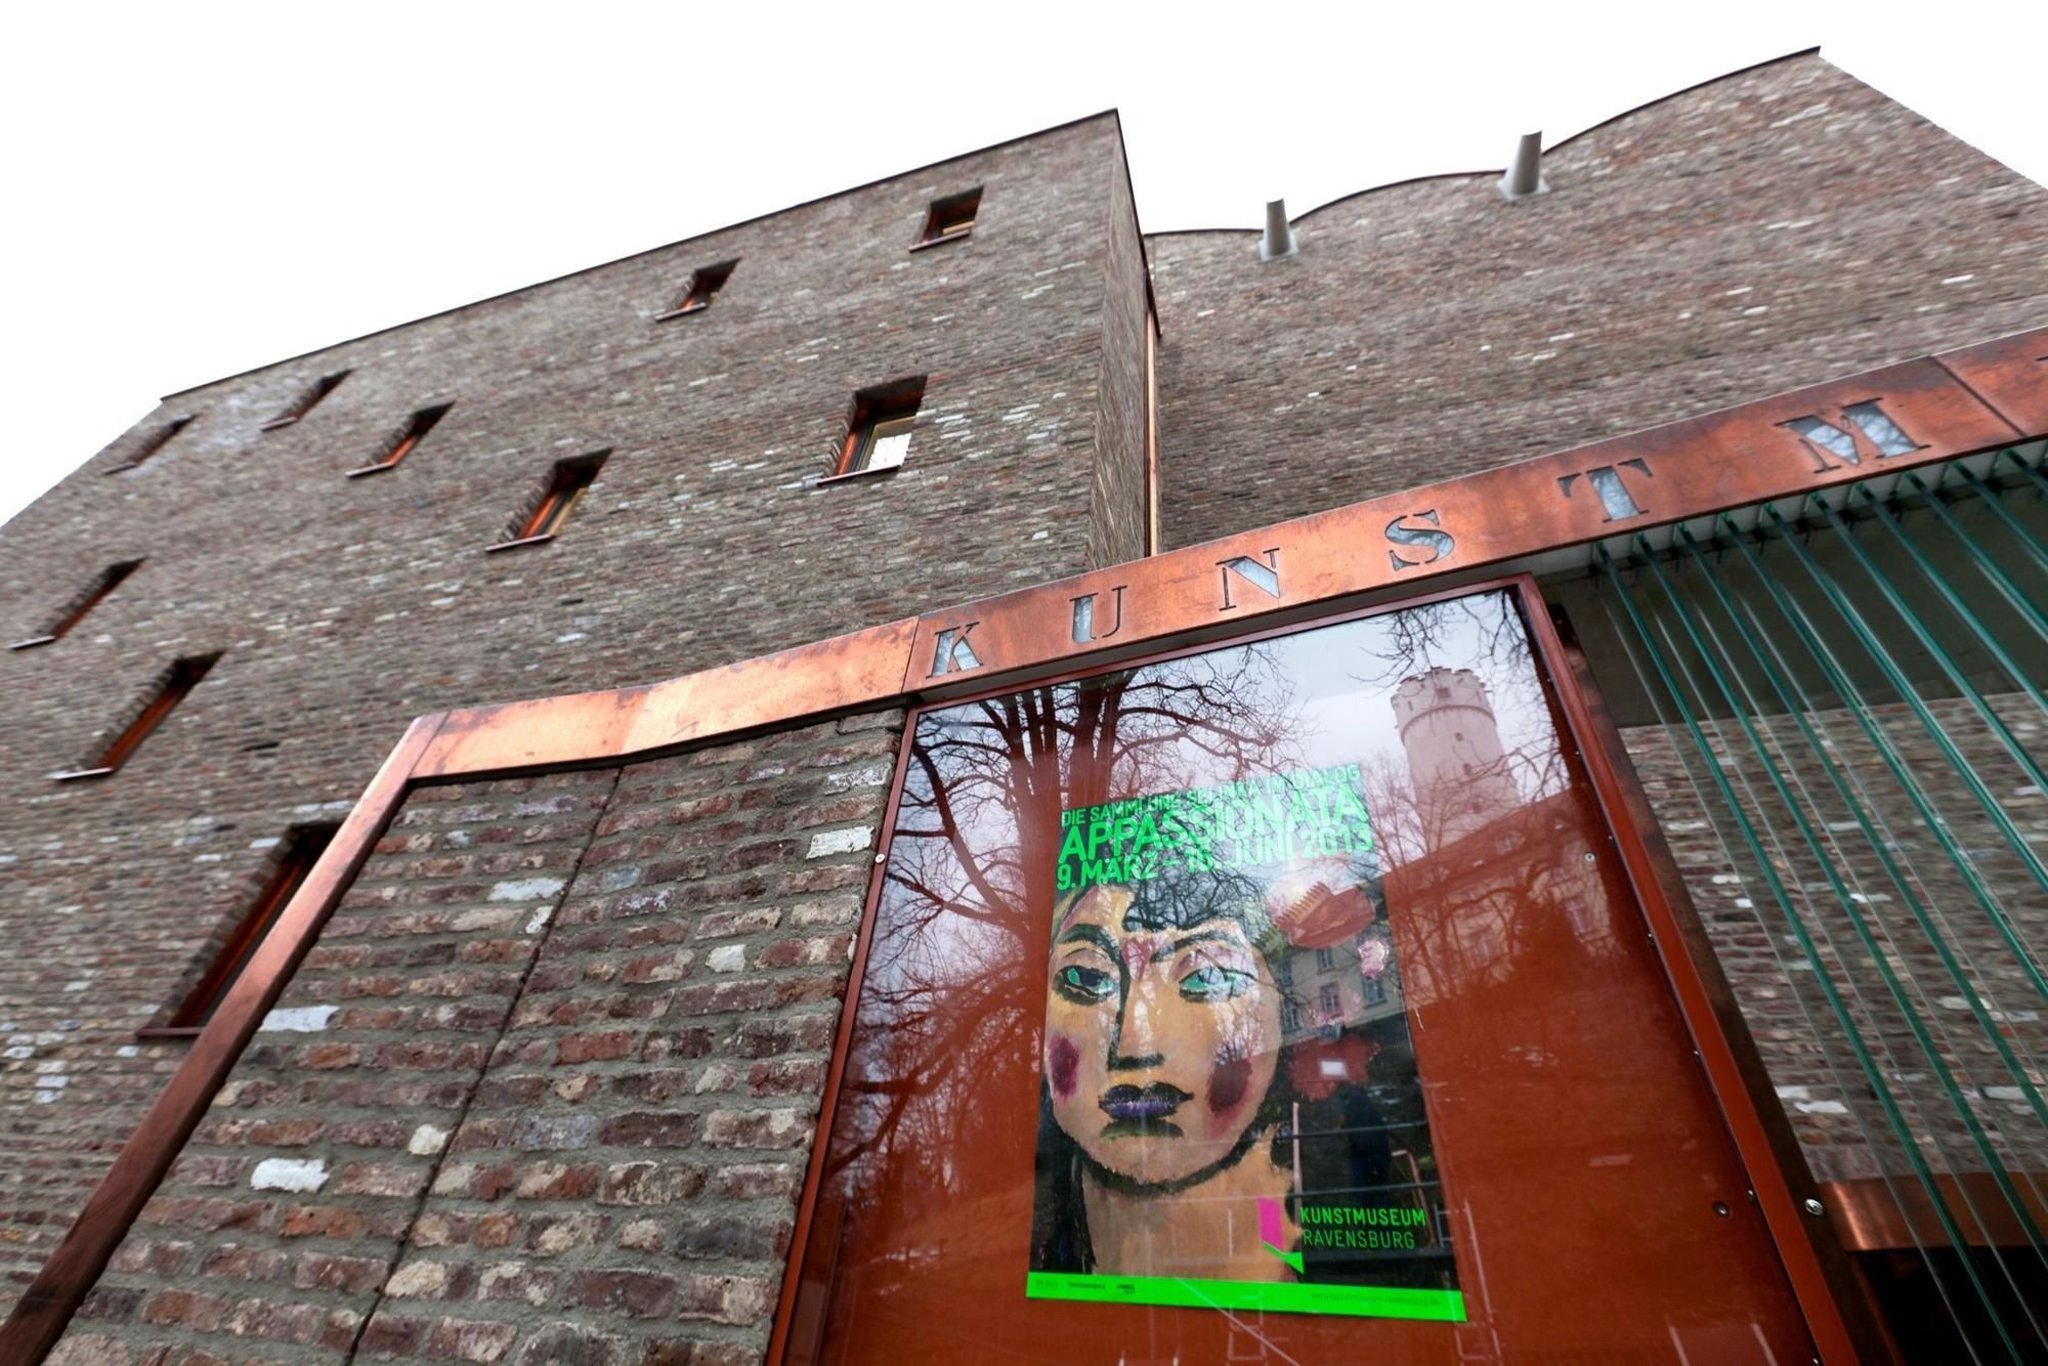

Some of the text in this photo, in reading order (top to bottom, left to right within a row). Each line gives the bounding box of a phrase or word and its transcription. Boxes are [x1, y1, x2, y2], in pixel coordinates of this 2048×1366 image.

[926, 355, 2048, 679] KUNSTM
[1058, 783, 1369, 864] APPASSIONATA
[1061, 808, 1086, 828] DIE
[1057, 864, 1077, 890] 9.
[1081, 851, 1158, 887] MÄRZ
[1227, 832, 1293, 868] JUNI
[1300, 821, 1374, 860] 2013
[1300, 1207, 1426, 1226] KUNSTMUSEUM
[1303, 1230, 1416, 1249] RAVENSBURG
